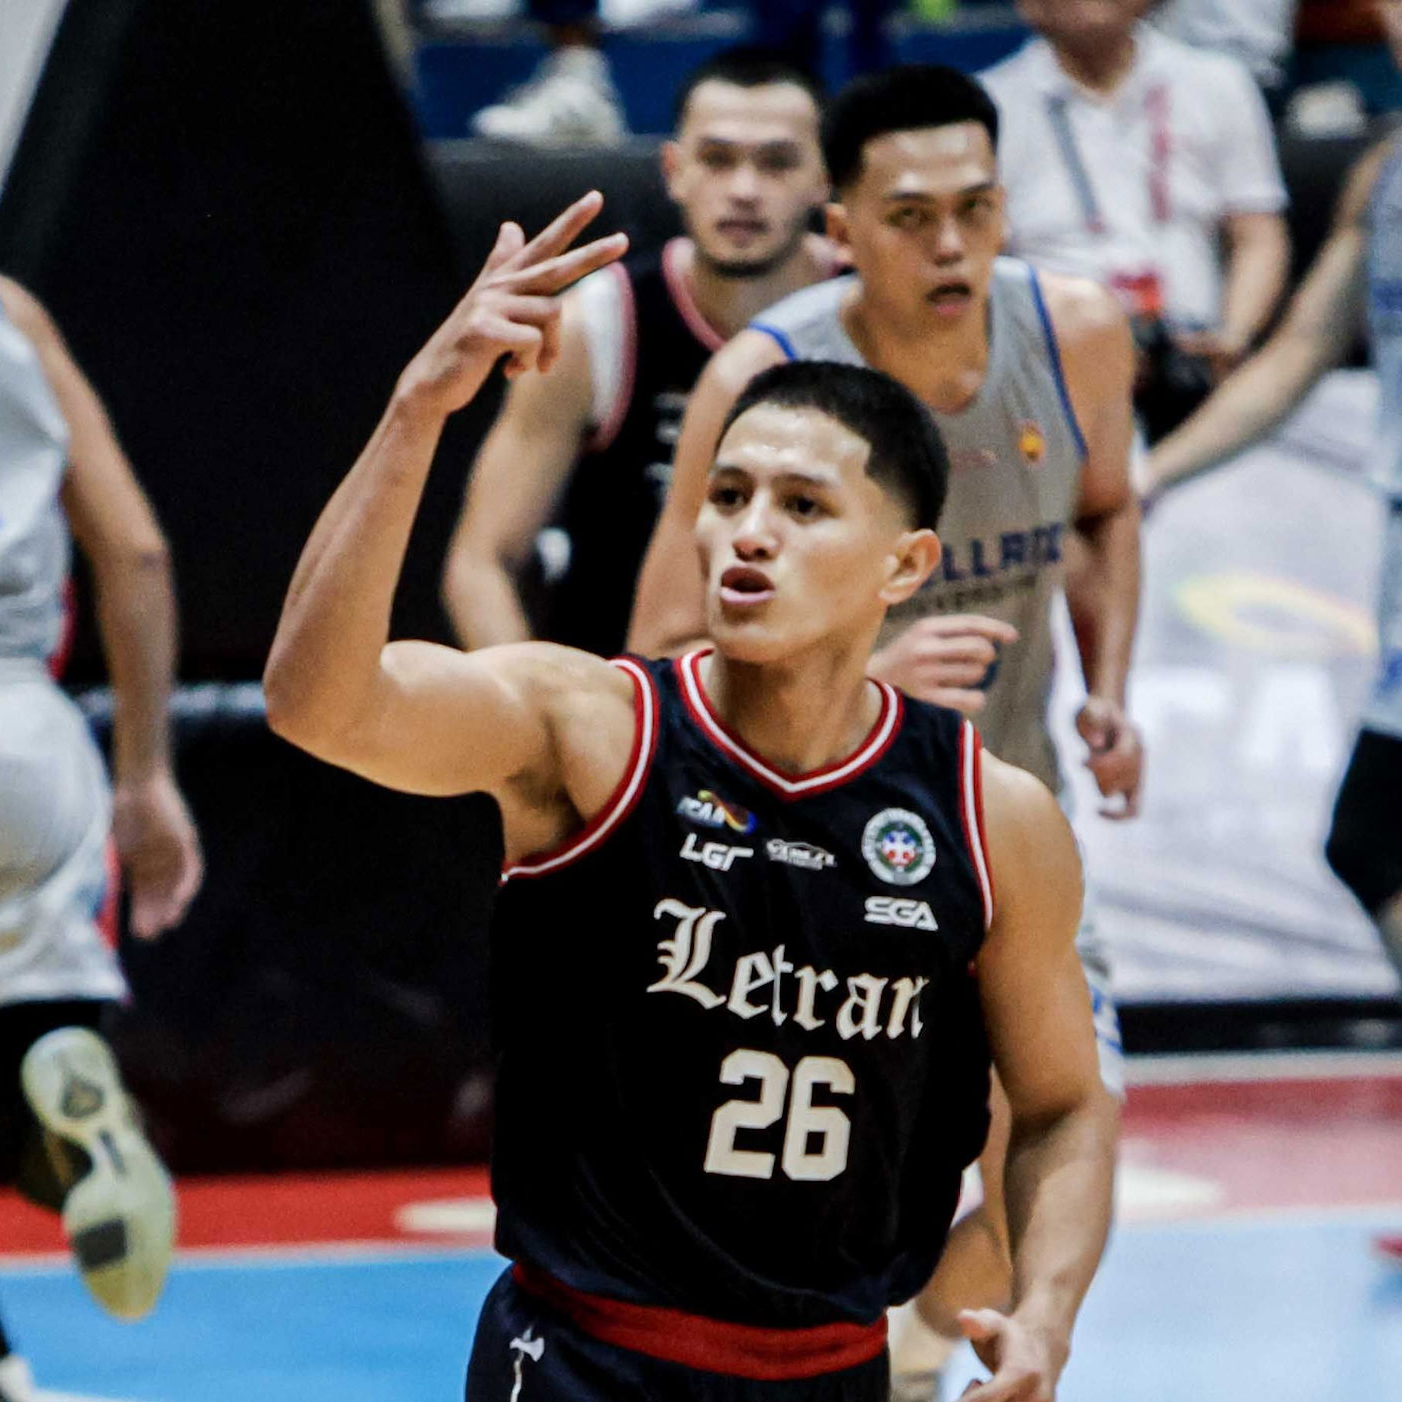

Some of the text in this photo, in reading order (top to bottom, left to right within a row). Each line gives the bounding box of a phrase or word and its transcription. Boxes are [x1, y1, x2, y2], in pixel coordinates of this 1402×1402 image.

[647, 898, 930, 1040] Letran
[864, 896, 939, 931] SGA
[704, 1049, 856, 1181] 26
